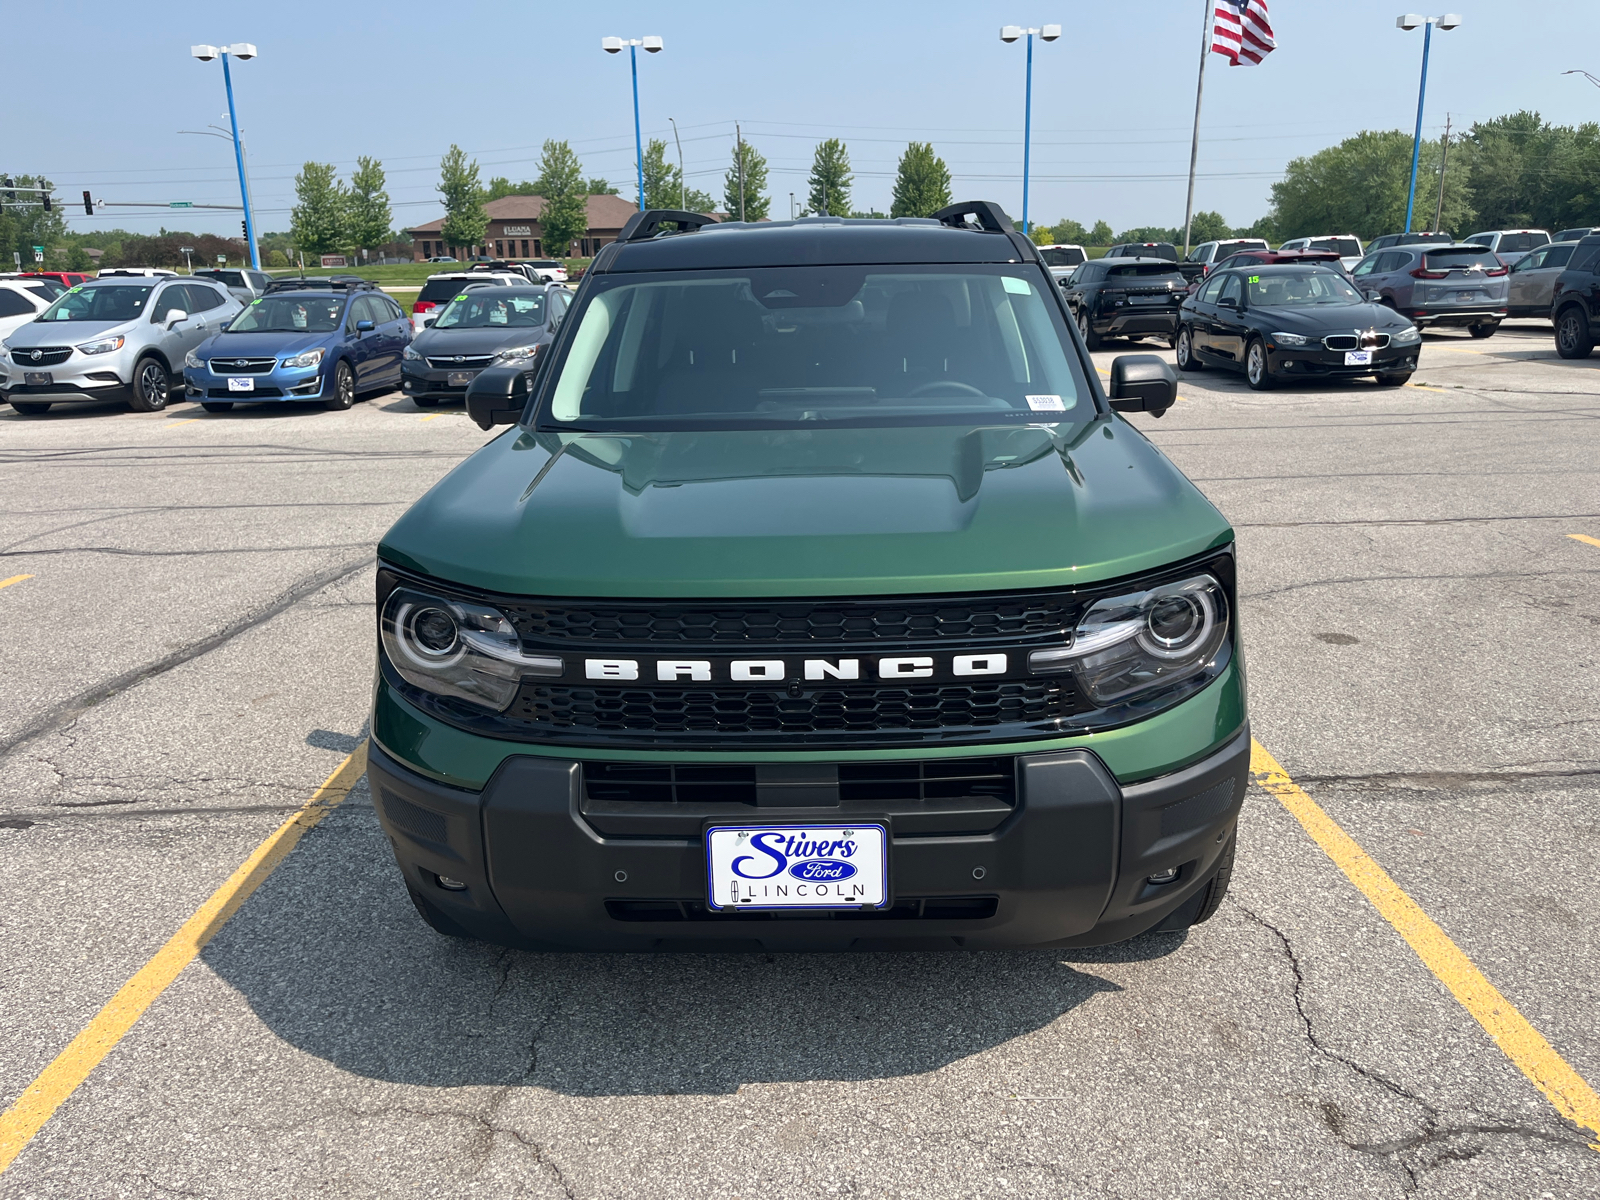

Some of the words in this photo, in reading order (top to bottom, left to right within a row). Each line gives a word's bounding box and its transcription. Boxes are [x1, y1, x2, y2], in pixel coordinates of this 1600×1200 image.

[1248, 275, 1259, 284] 15
[584, 653, 1008, 681] BRONCO
[731, 831, 858, 880] Stivers
[802, 861, 842, 878] Ford
[748, 884, 865, 897] LINCOLN
